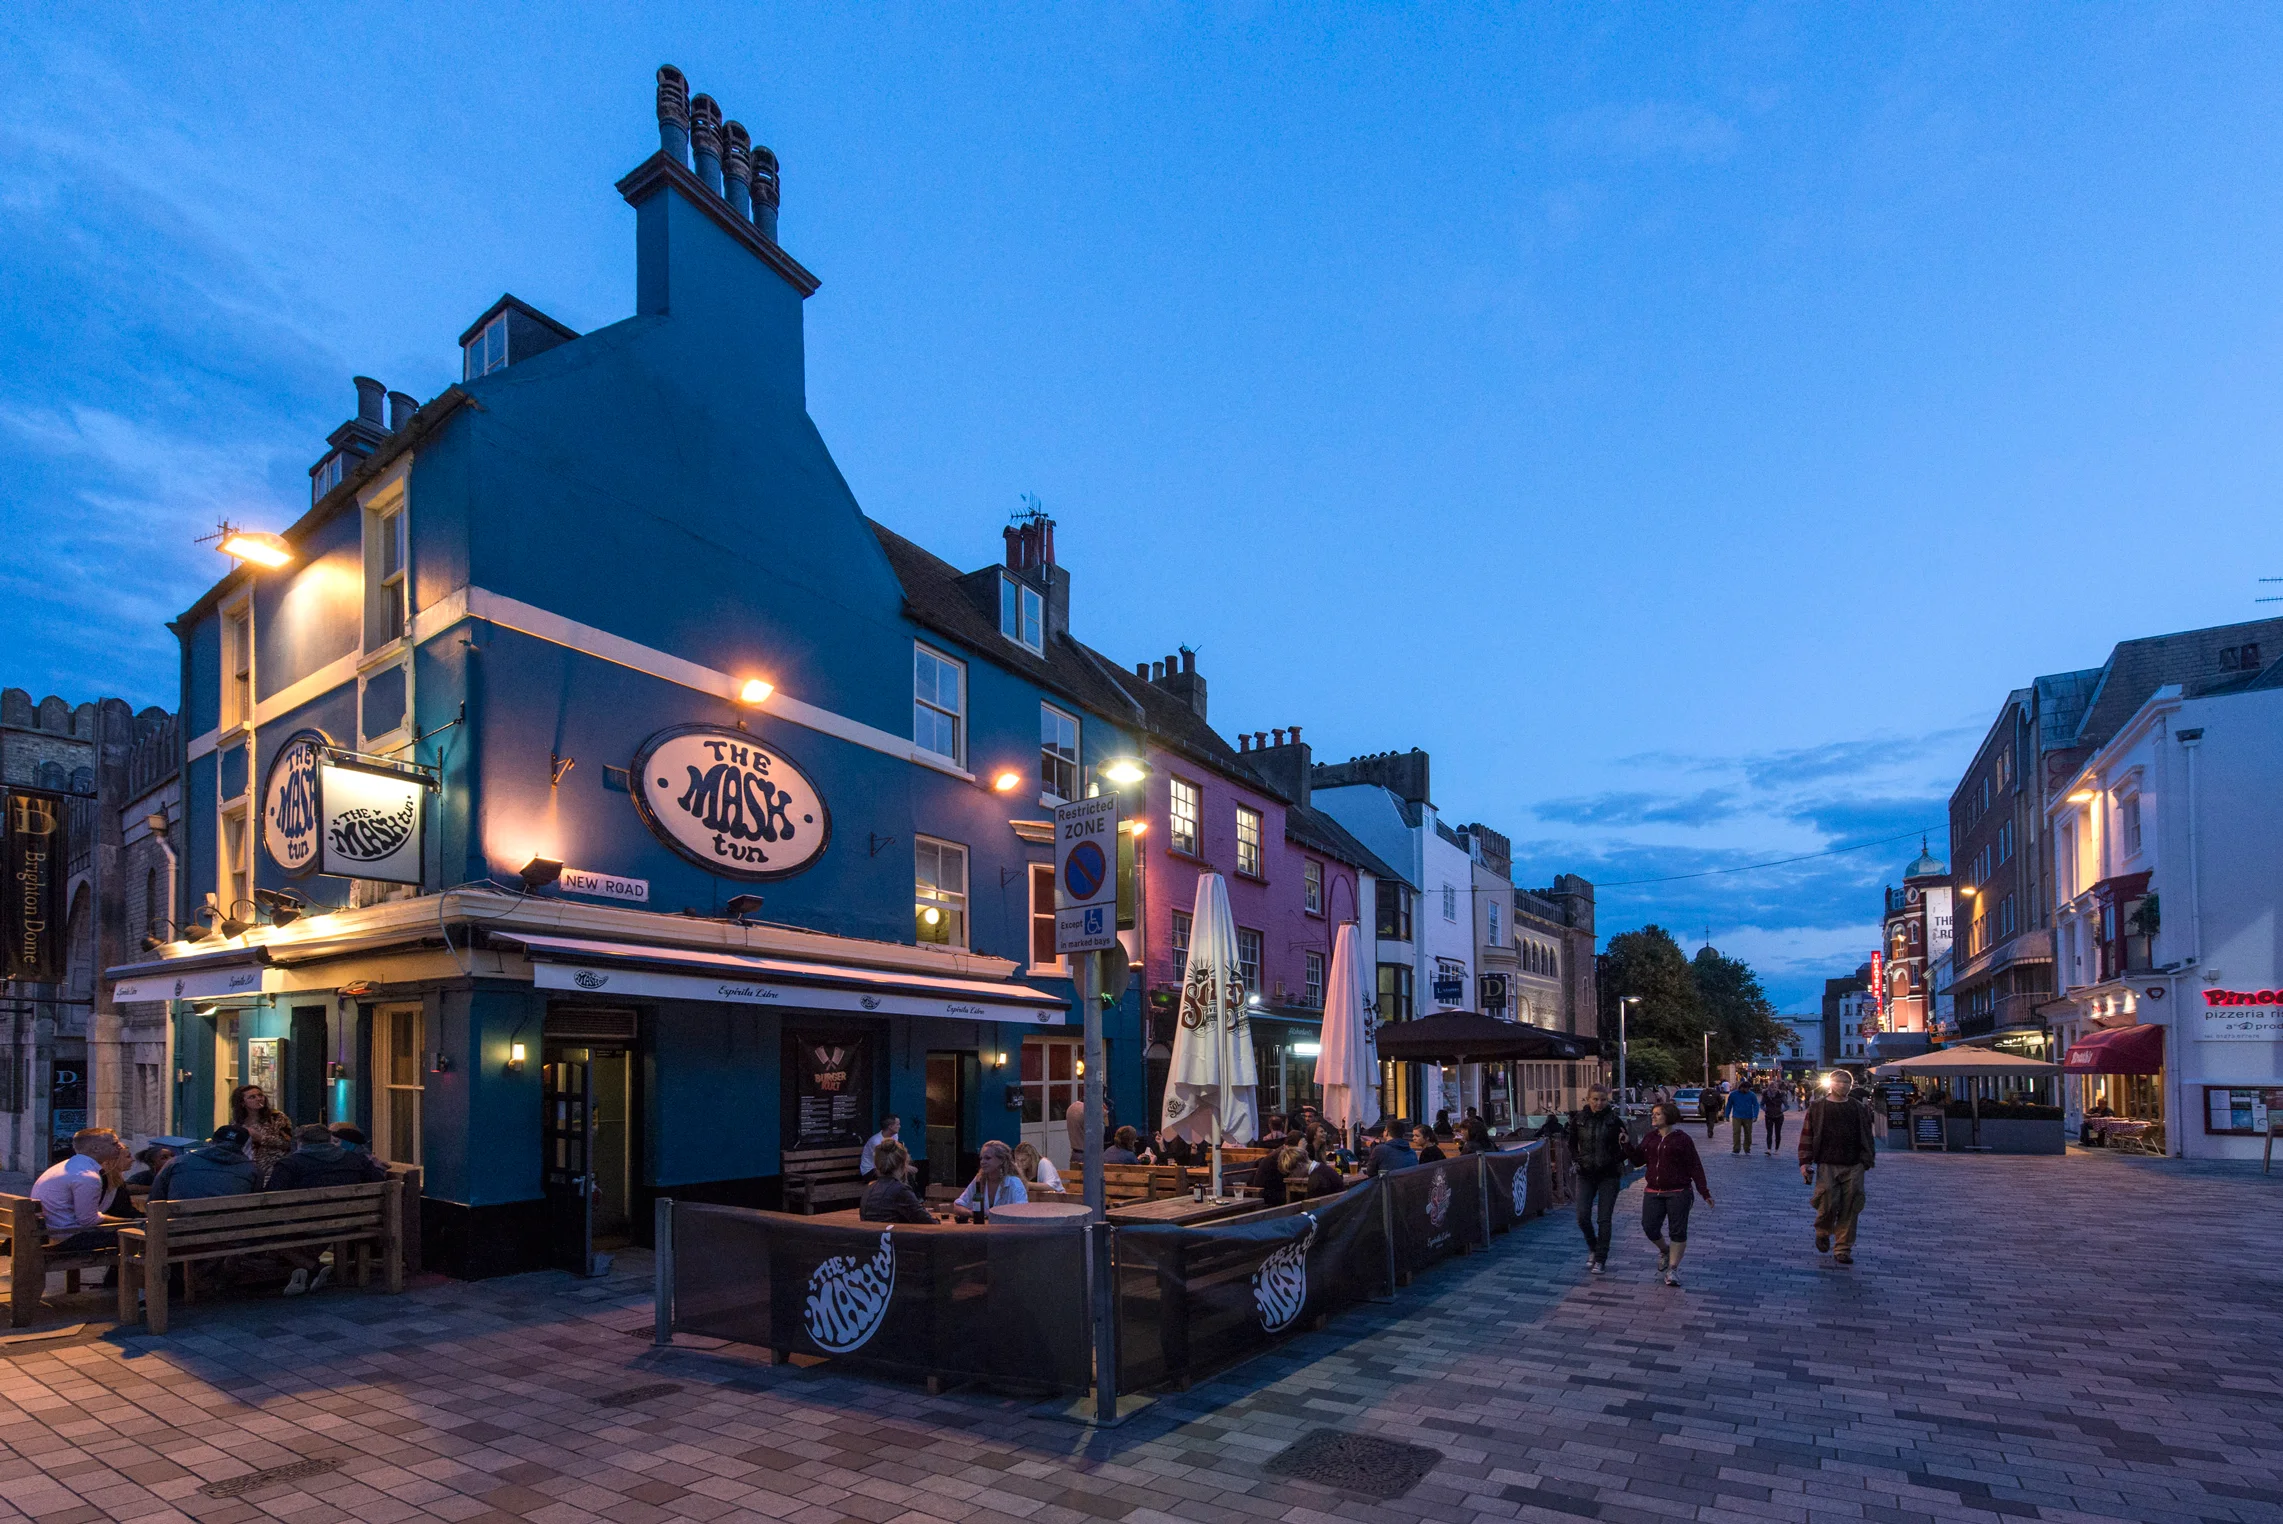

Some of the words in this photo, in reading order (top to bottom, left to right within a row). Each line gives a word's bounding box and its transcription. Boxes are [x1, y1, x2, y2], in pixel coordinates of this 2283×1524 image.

[286, 744, 312, 772] THE
[703, 741, 771, 775] THE
[677, 764, 795, 842] MASH
[1058, 798, 1114, 821] Restricted
[339, 808, 371, 822] THE
[330, 815, 408, 857] MASH
[398, 800, 414, 824] tun
[1065, 817, 1105, 840] ZONE
[288, 840, 310, 860] tun
[712, 834, 769, 863] tun
[16, 852, 46, 915] Brighton
[566, 875, 598, 890] NEW
[606, 881, 644, 896] ROAD
[1061, 920, 1083, 930] Except
[23, 920, 45, 963] Dome
[1061, 941, 1067, 949] in
[1068, 938, 1092, 948] marked
[1094, 936, 1110, 947] bays
[1484, 980, 1503, 996] D
[2205, 1010, 2264, 1020] pizzeria
[56, 1070, 78, 1084] D
[814, 1071, 847, 1083] BURGER
[872, 1232, 892, 1278] tun
[813, 1256, 846, 1284] THE
[807, 1263, 888, 1344] MASH
